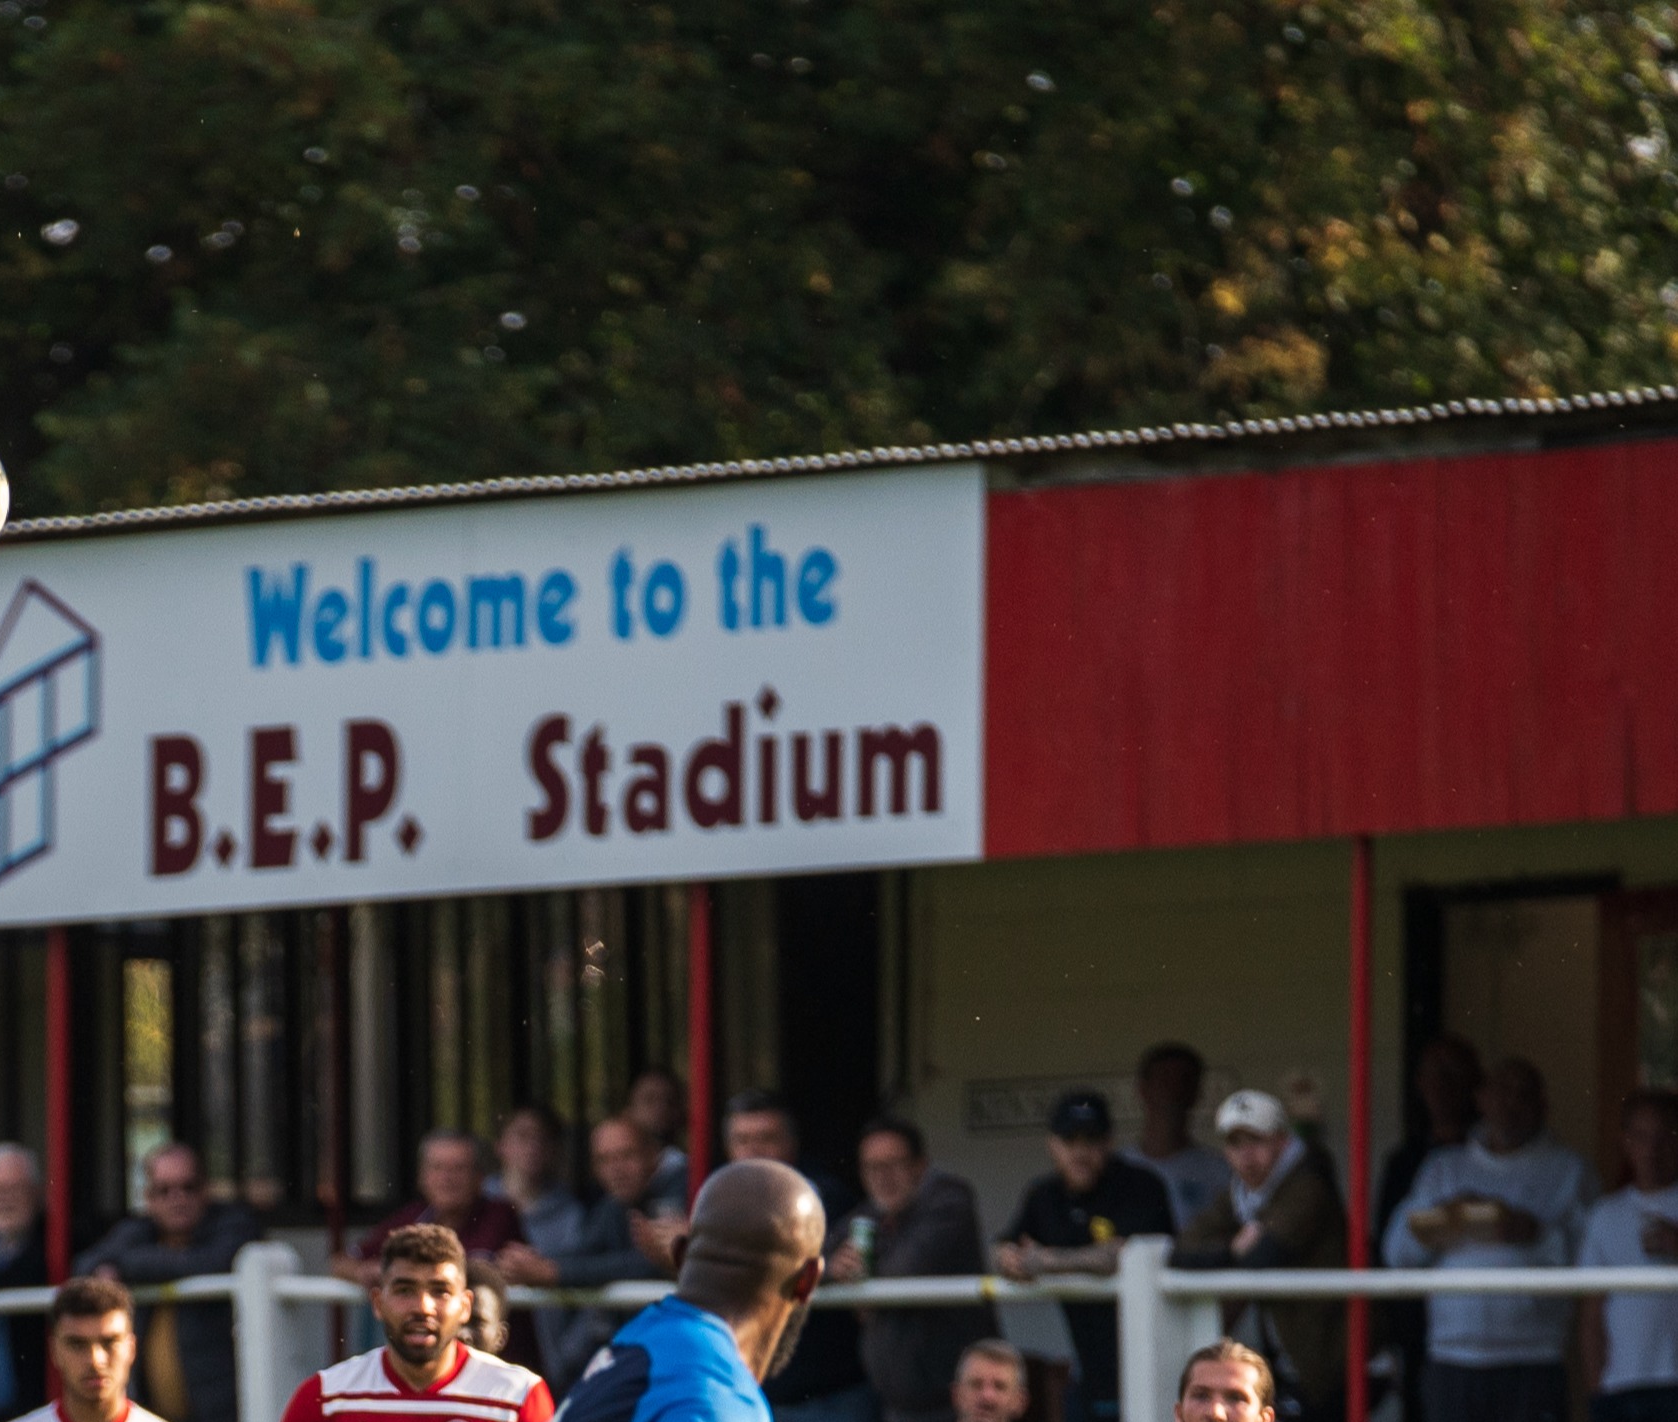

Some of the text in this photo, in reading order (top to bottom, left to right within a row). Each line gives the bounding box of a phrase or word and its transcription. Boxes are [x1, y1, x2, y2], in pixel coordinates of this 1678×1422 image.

[248, 522, 837, 668] Welcome to the
[150, 683, 942, 878] B.E.P. Stadium
